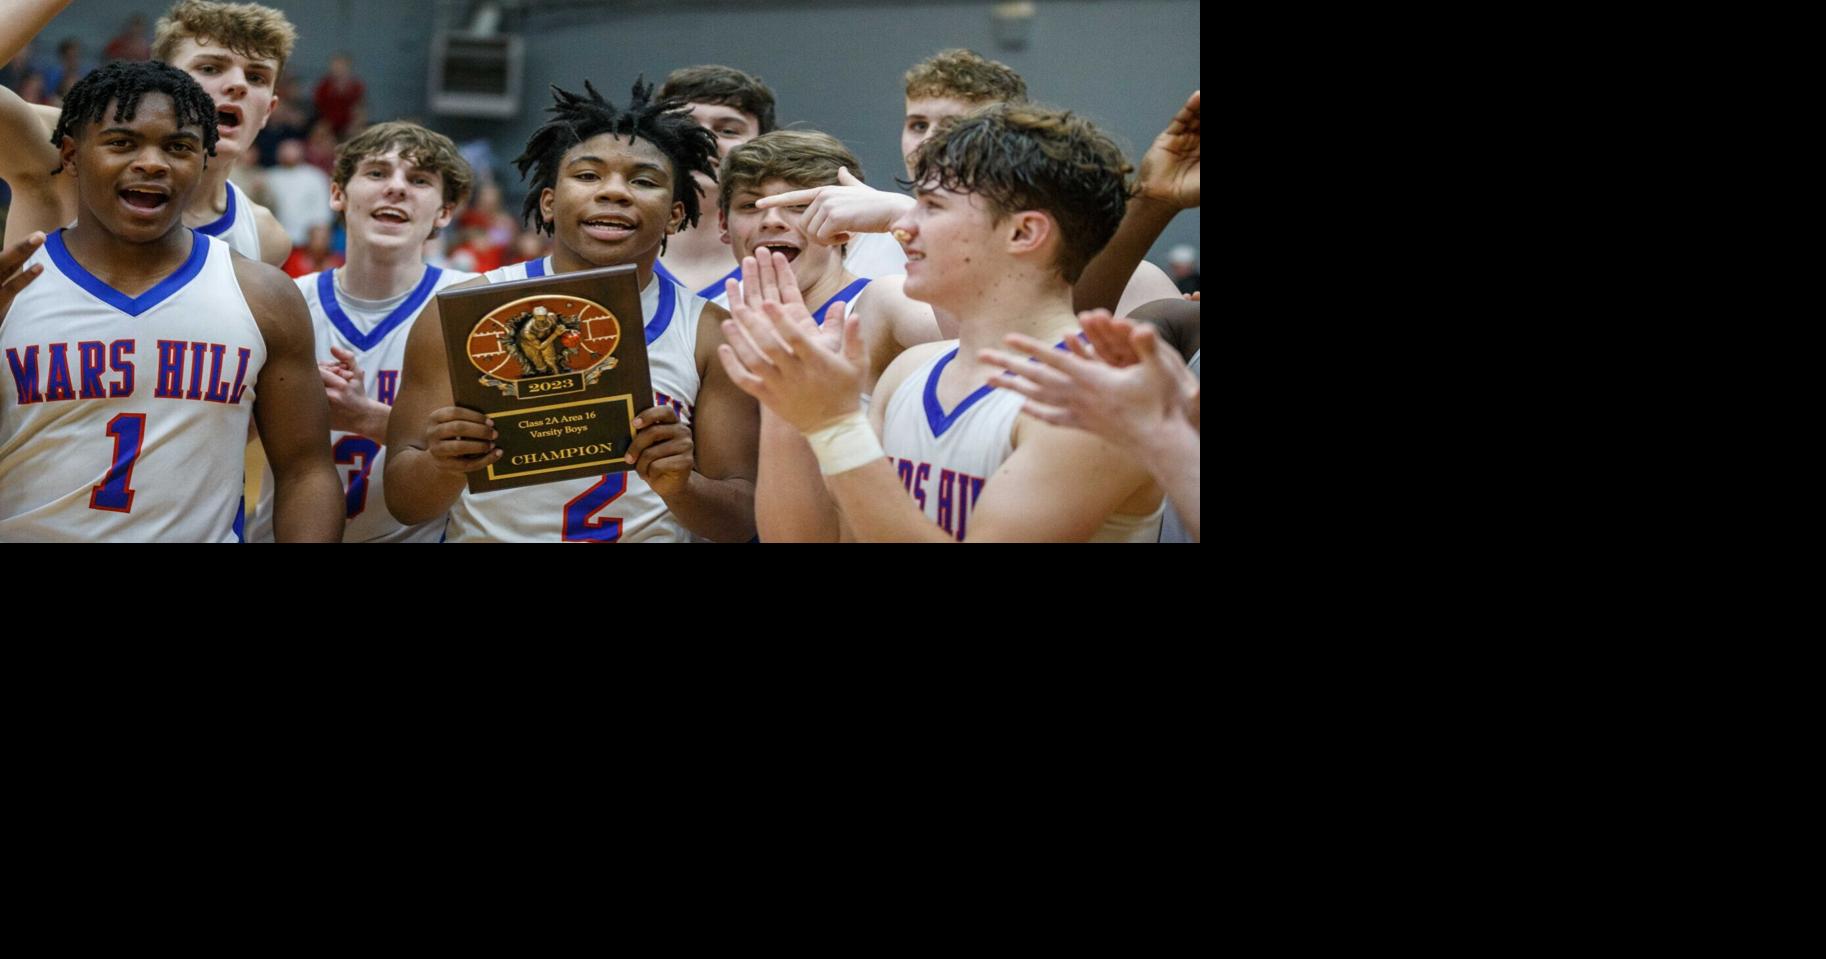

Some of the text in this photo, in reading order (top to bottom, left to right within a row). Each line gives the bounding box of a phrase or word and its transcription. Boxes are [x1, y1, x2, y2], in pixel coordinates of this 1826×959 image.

[6, 339, 251, 405] MARS HILL
[528, 378, 574, 393] 2023
[518, 410, 597, 429] Class 2A Area 16
[530, 424, 588, 438] Varsity Boys
[89, 412, 147, 513] 1
[511, 442, 613, 466] CHAMPION
[561, 470, 628, 543] 2
